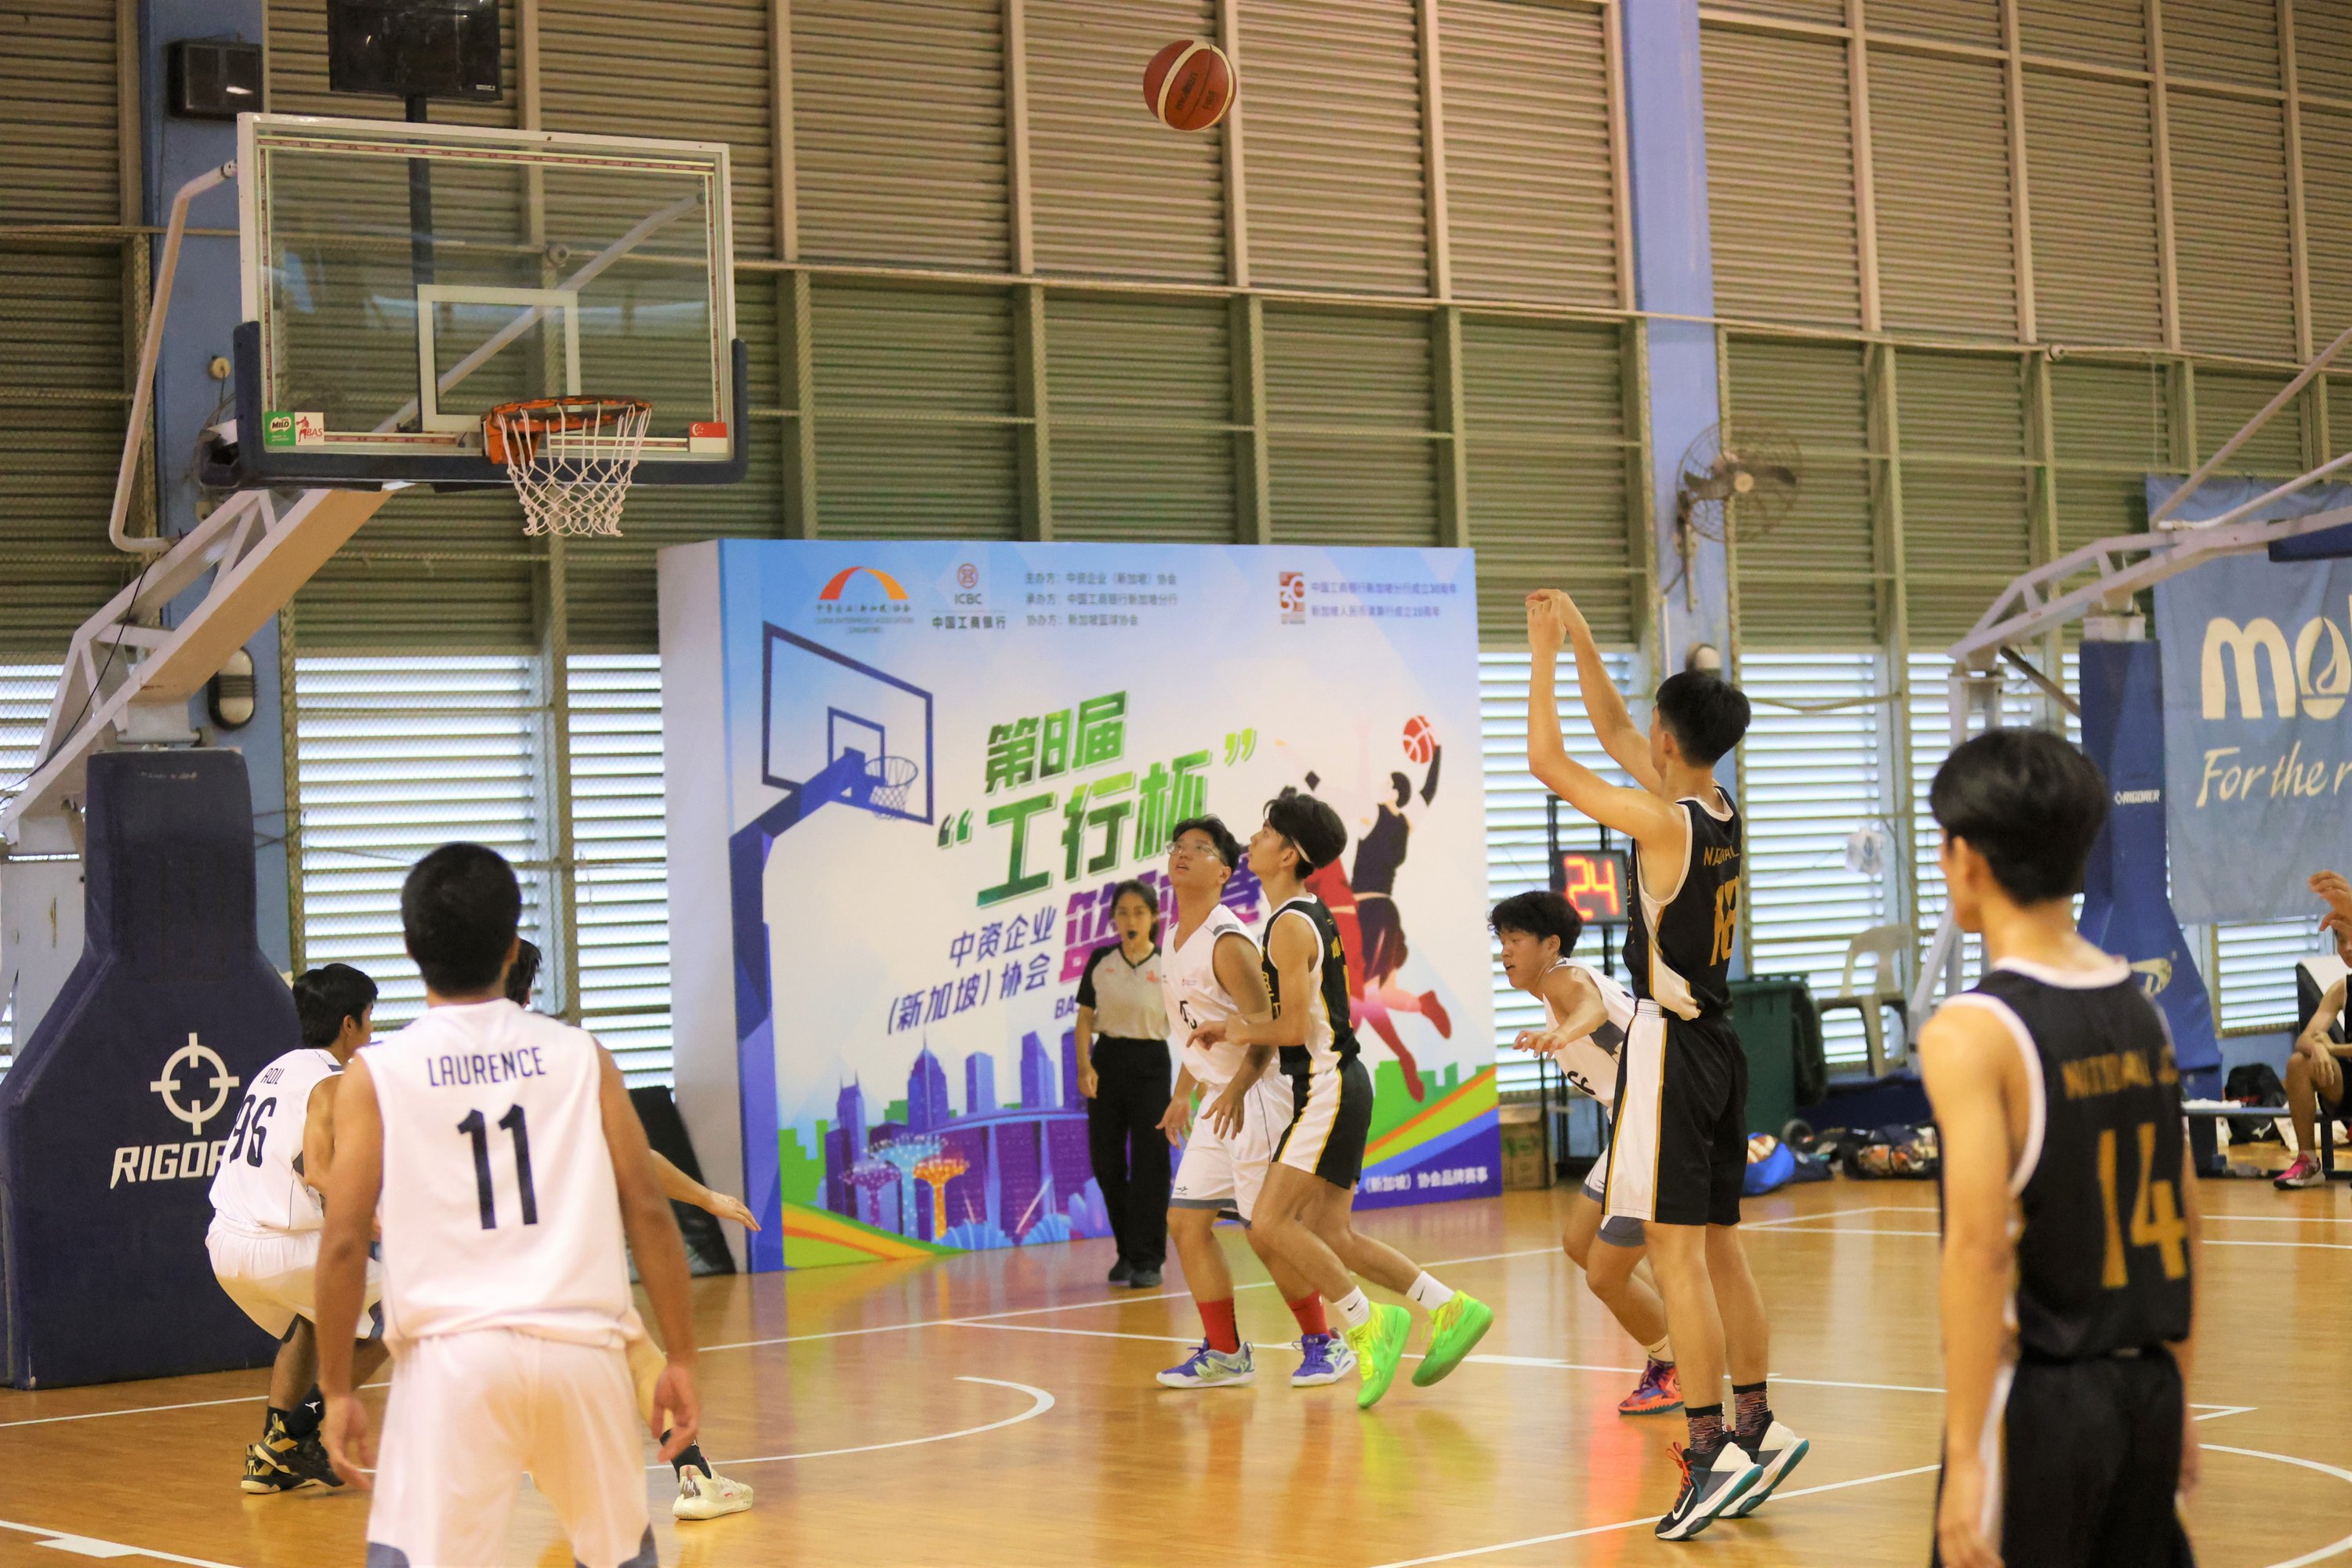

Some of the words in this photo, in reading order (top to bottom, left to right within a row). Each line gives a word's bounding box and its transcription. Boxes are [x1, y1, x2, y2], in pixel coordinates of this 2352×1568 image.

[307, 428, 323, 437] BAS
[931, 615, 1007, 630] 中国工商银行
[955, 593, 982, 605] ICBC
[2201, 593, 2352, 720] mo
[985, 690, 1127, 796] 第8届
[2197, 746, 2266, 809] For
[2271, 740, 2328, 800] the
[1563, 855, 1621, 922] 24
[1710, 875, 1740, 967] 18
[949, 906, 1057, 968] 中资企业
[427, 1047, 546, 1087] LAURENCE
[229, 1094, 278, 1168] 96
[456, 1103, 539, 1230] 11
[2096, 1122, 2188, 1290] 14
